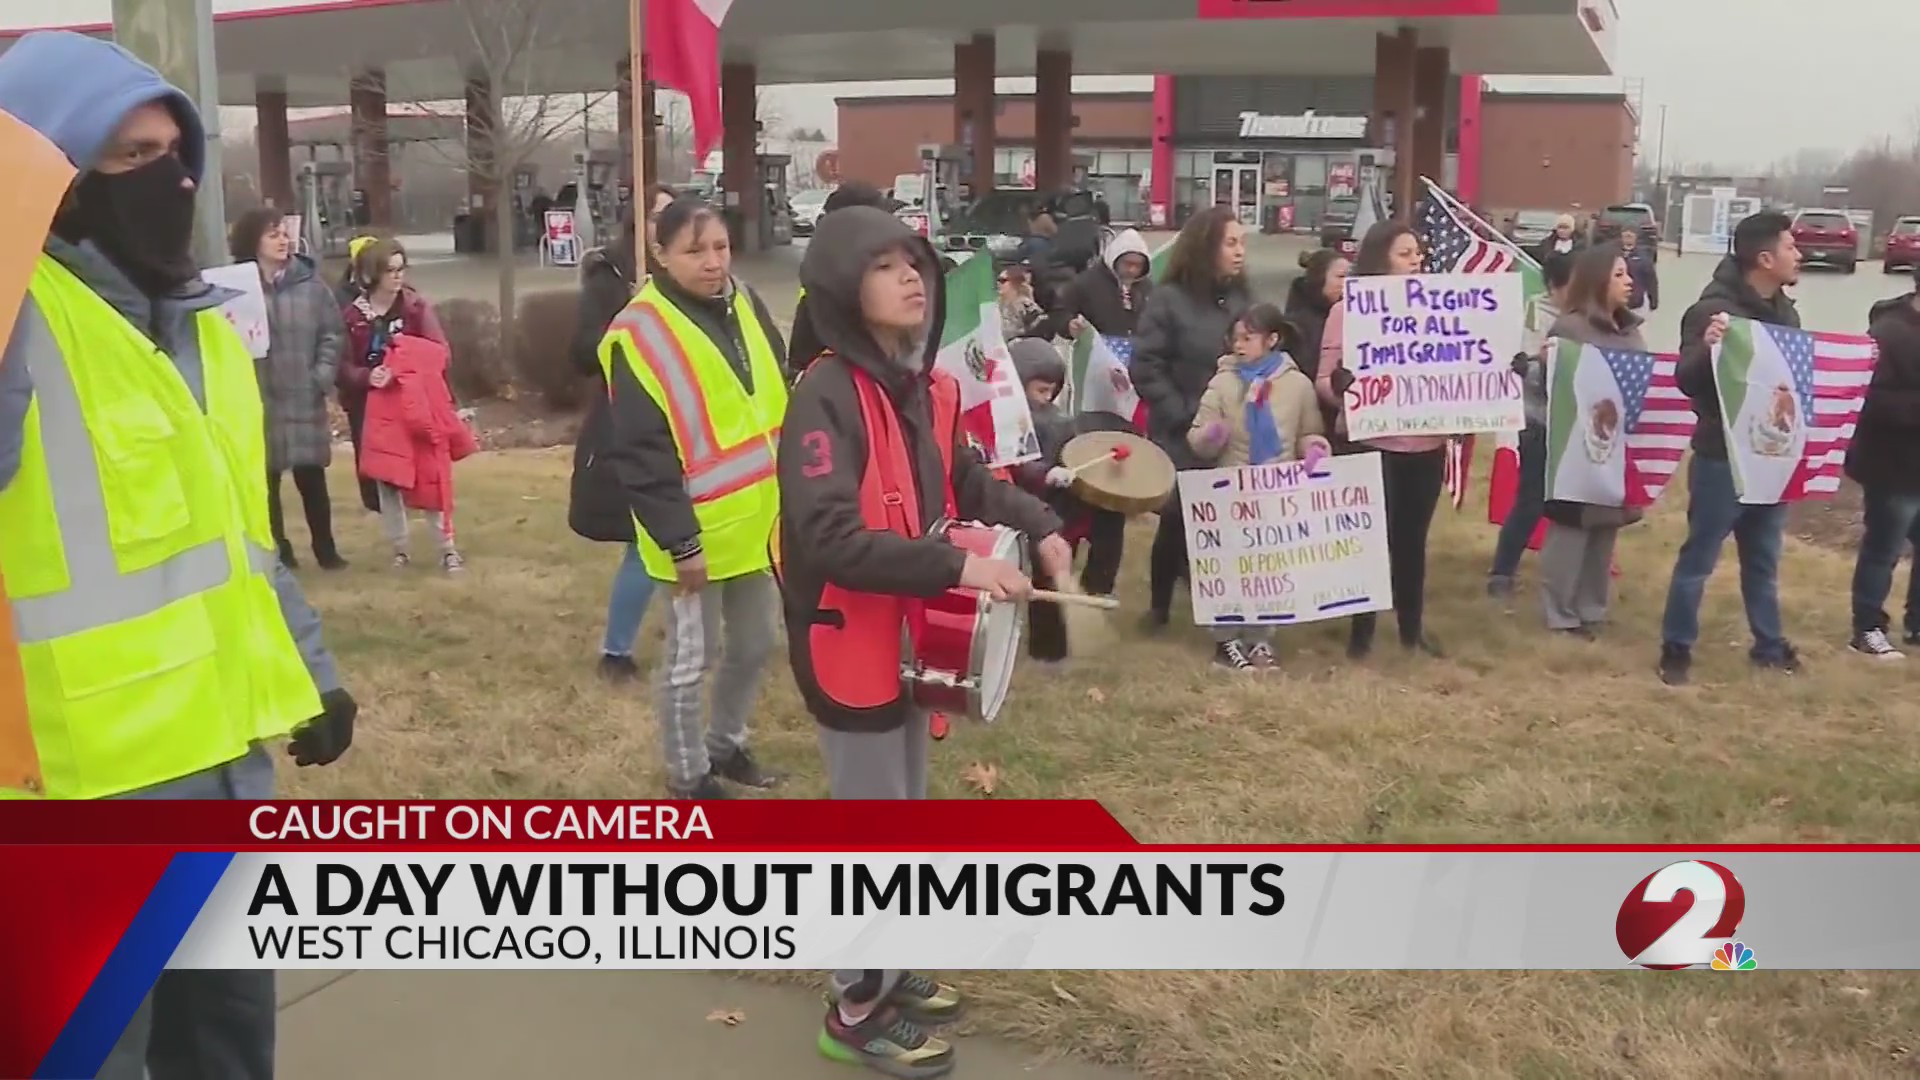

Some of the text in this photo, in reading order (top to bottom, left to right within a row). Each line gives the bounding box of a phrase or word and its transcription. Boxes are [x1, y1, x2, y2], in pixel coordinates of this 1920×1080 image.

[1346, 278, 1498, 315] FULL RIGHTS
[1381, 315, 1470, 336] FOR ALL
[1357, 339, 1493, 370] IMMIGRANTS
[1346, 374, 1393, 411] STOP
[802, 430, 833, 478] 3
[1238, 464, 1306, 491] TRUMP
[1192, 502, 1217, 522] NO
[1281, 496, 1298, 516] IS
[1196, 529, 1221, 549] ON
[1197, 559, 1220, 576] NO
[1199, 579, 1225, 598] NO
[1241, 574, 1295, 598] RAIDS
